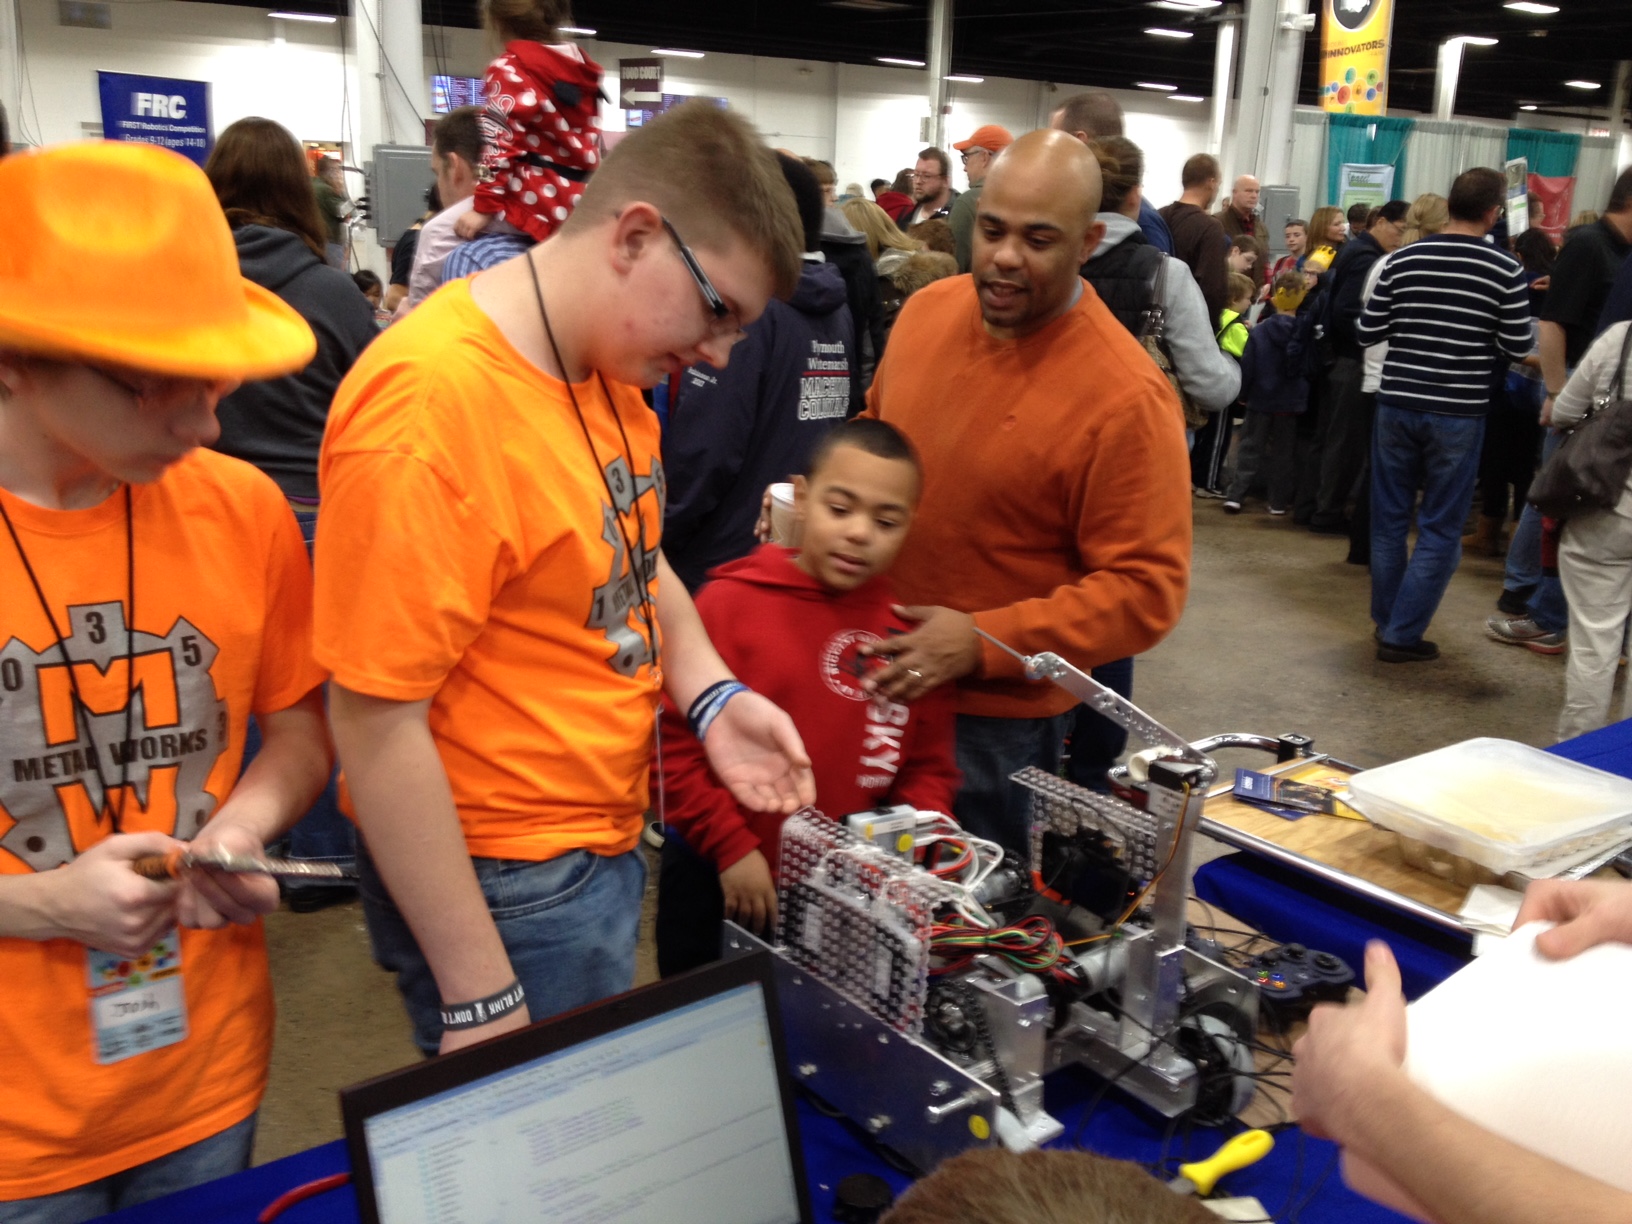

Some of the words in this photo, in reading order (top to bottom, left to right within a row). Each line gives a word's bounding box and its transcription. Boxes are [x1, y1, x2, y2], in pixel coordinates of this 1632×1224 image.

[134, 92, 187, 120] FRC
[168, 124, 206, 134] Competition
[85, 611, 107, 645] 3
[181, 635, 203, 667] 5
